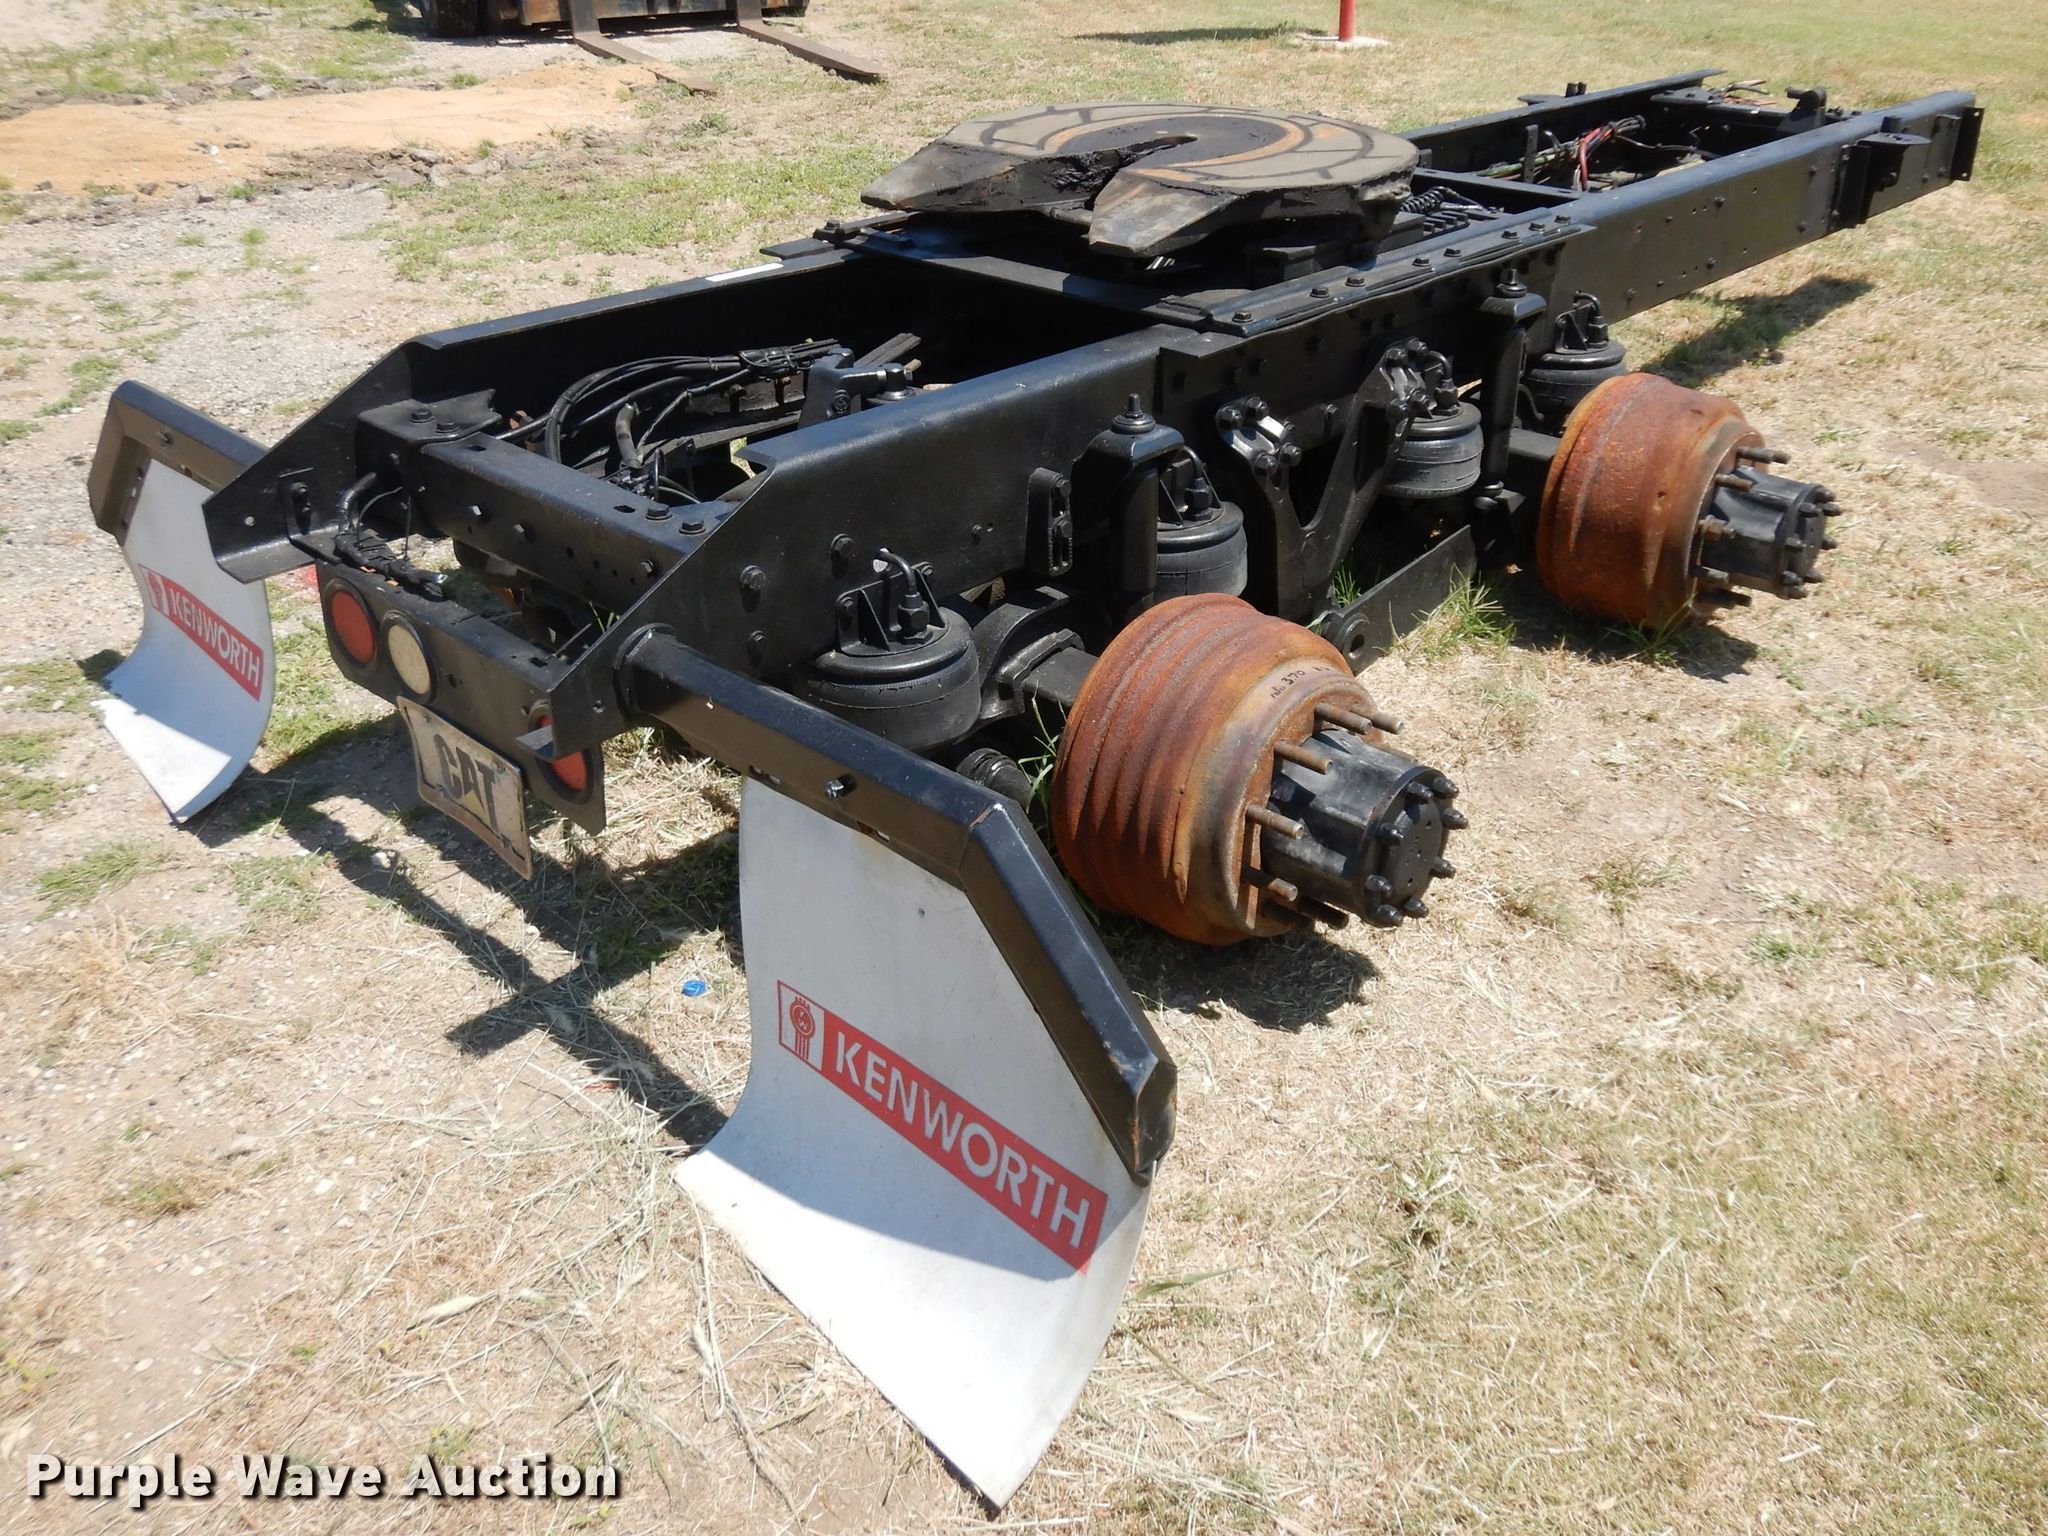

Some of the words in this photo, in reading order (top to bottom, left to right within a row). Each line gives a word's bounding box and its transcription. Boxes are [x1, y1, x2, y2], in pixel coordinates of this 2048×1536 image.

[170, 588, 260, 688] KENWORTH
[434, 734, 499, 833] CAT
[834, 1030, 1091, 1249] KENWORTH
